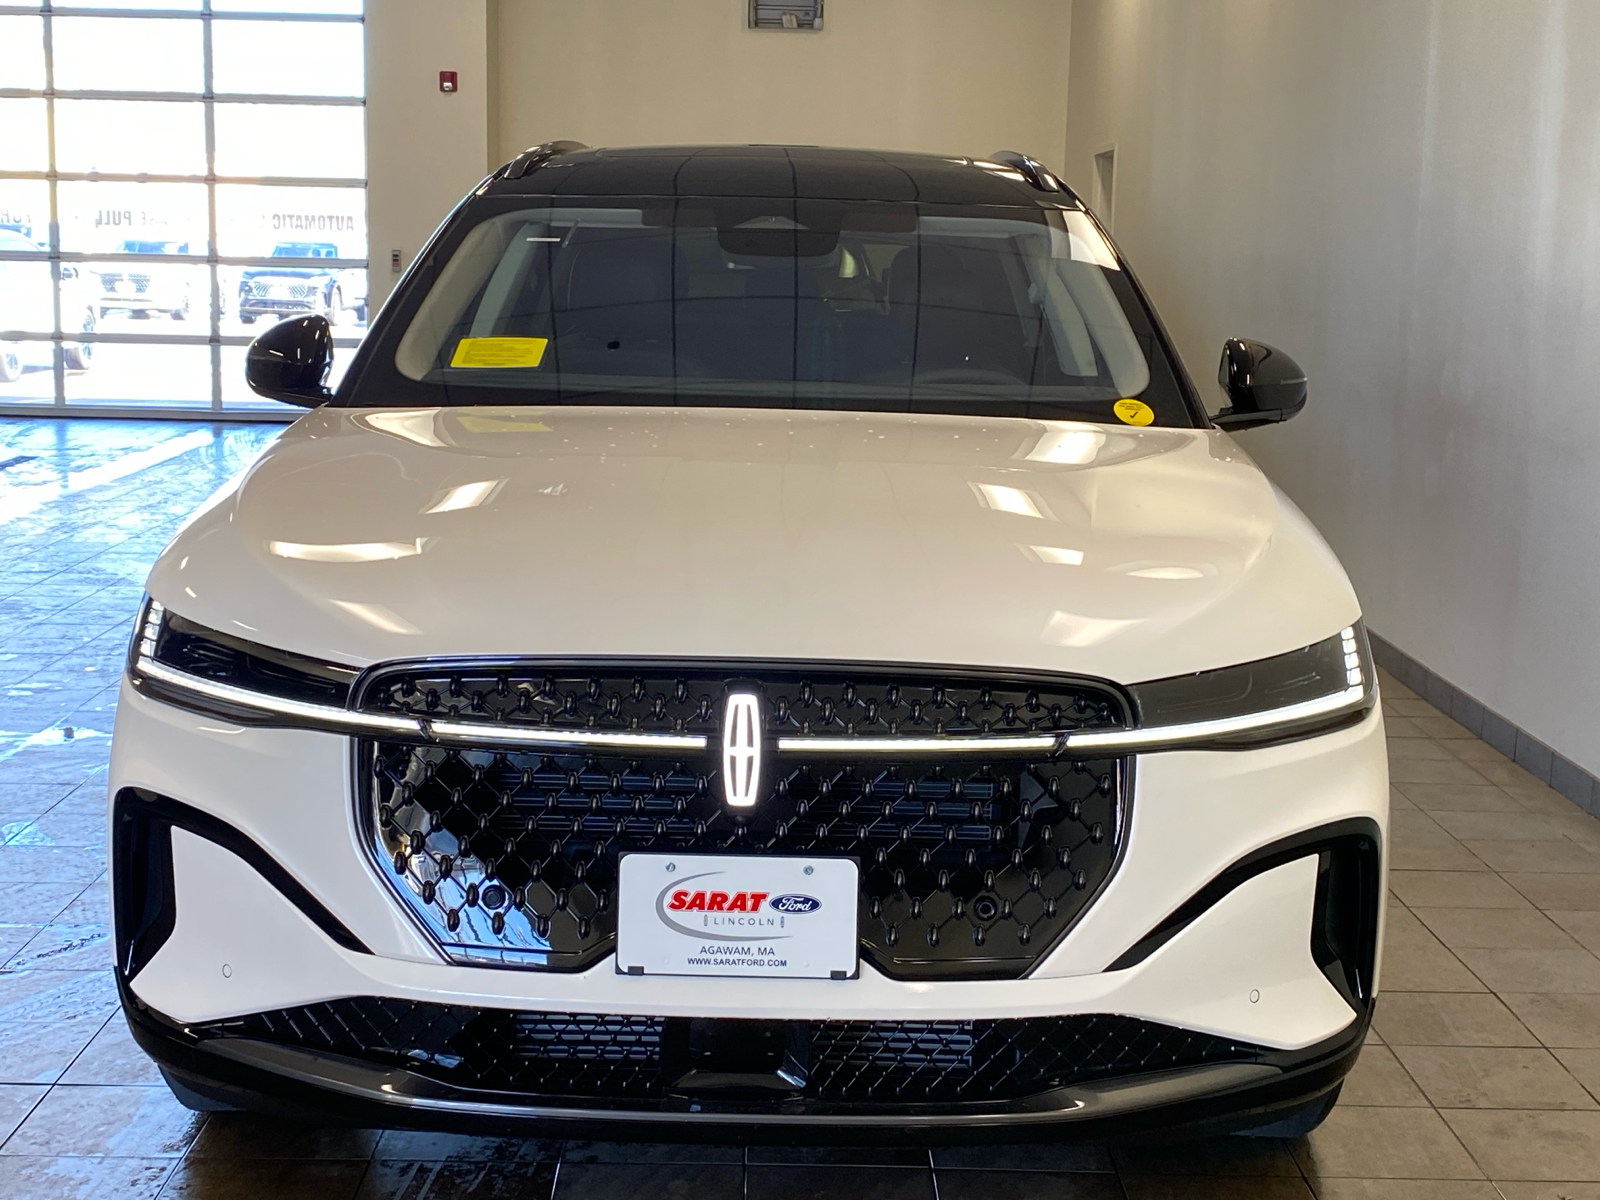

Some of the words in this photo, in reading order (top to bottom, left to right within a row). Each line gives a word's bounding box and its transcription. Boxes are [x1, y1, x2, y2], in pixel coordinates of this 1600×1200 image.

[667, 889, 769, 913] SARAT
[777, 896, 813, 912] Ford
[713, 917, 775, 927] LINCOLN
[699, 945, 754, 957] AGAWAM,
[757, 946, 776, 957] MA
[687, 957, 788, 968] WWW.SARATFORD.COM
